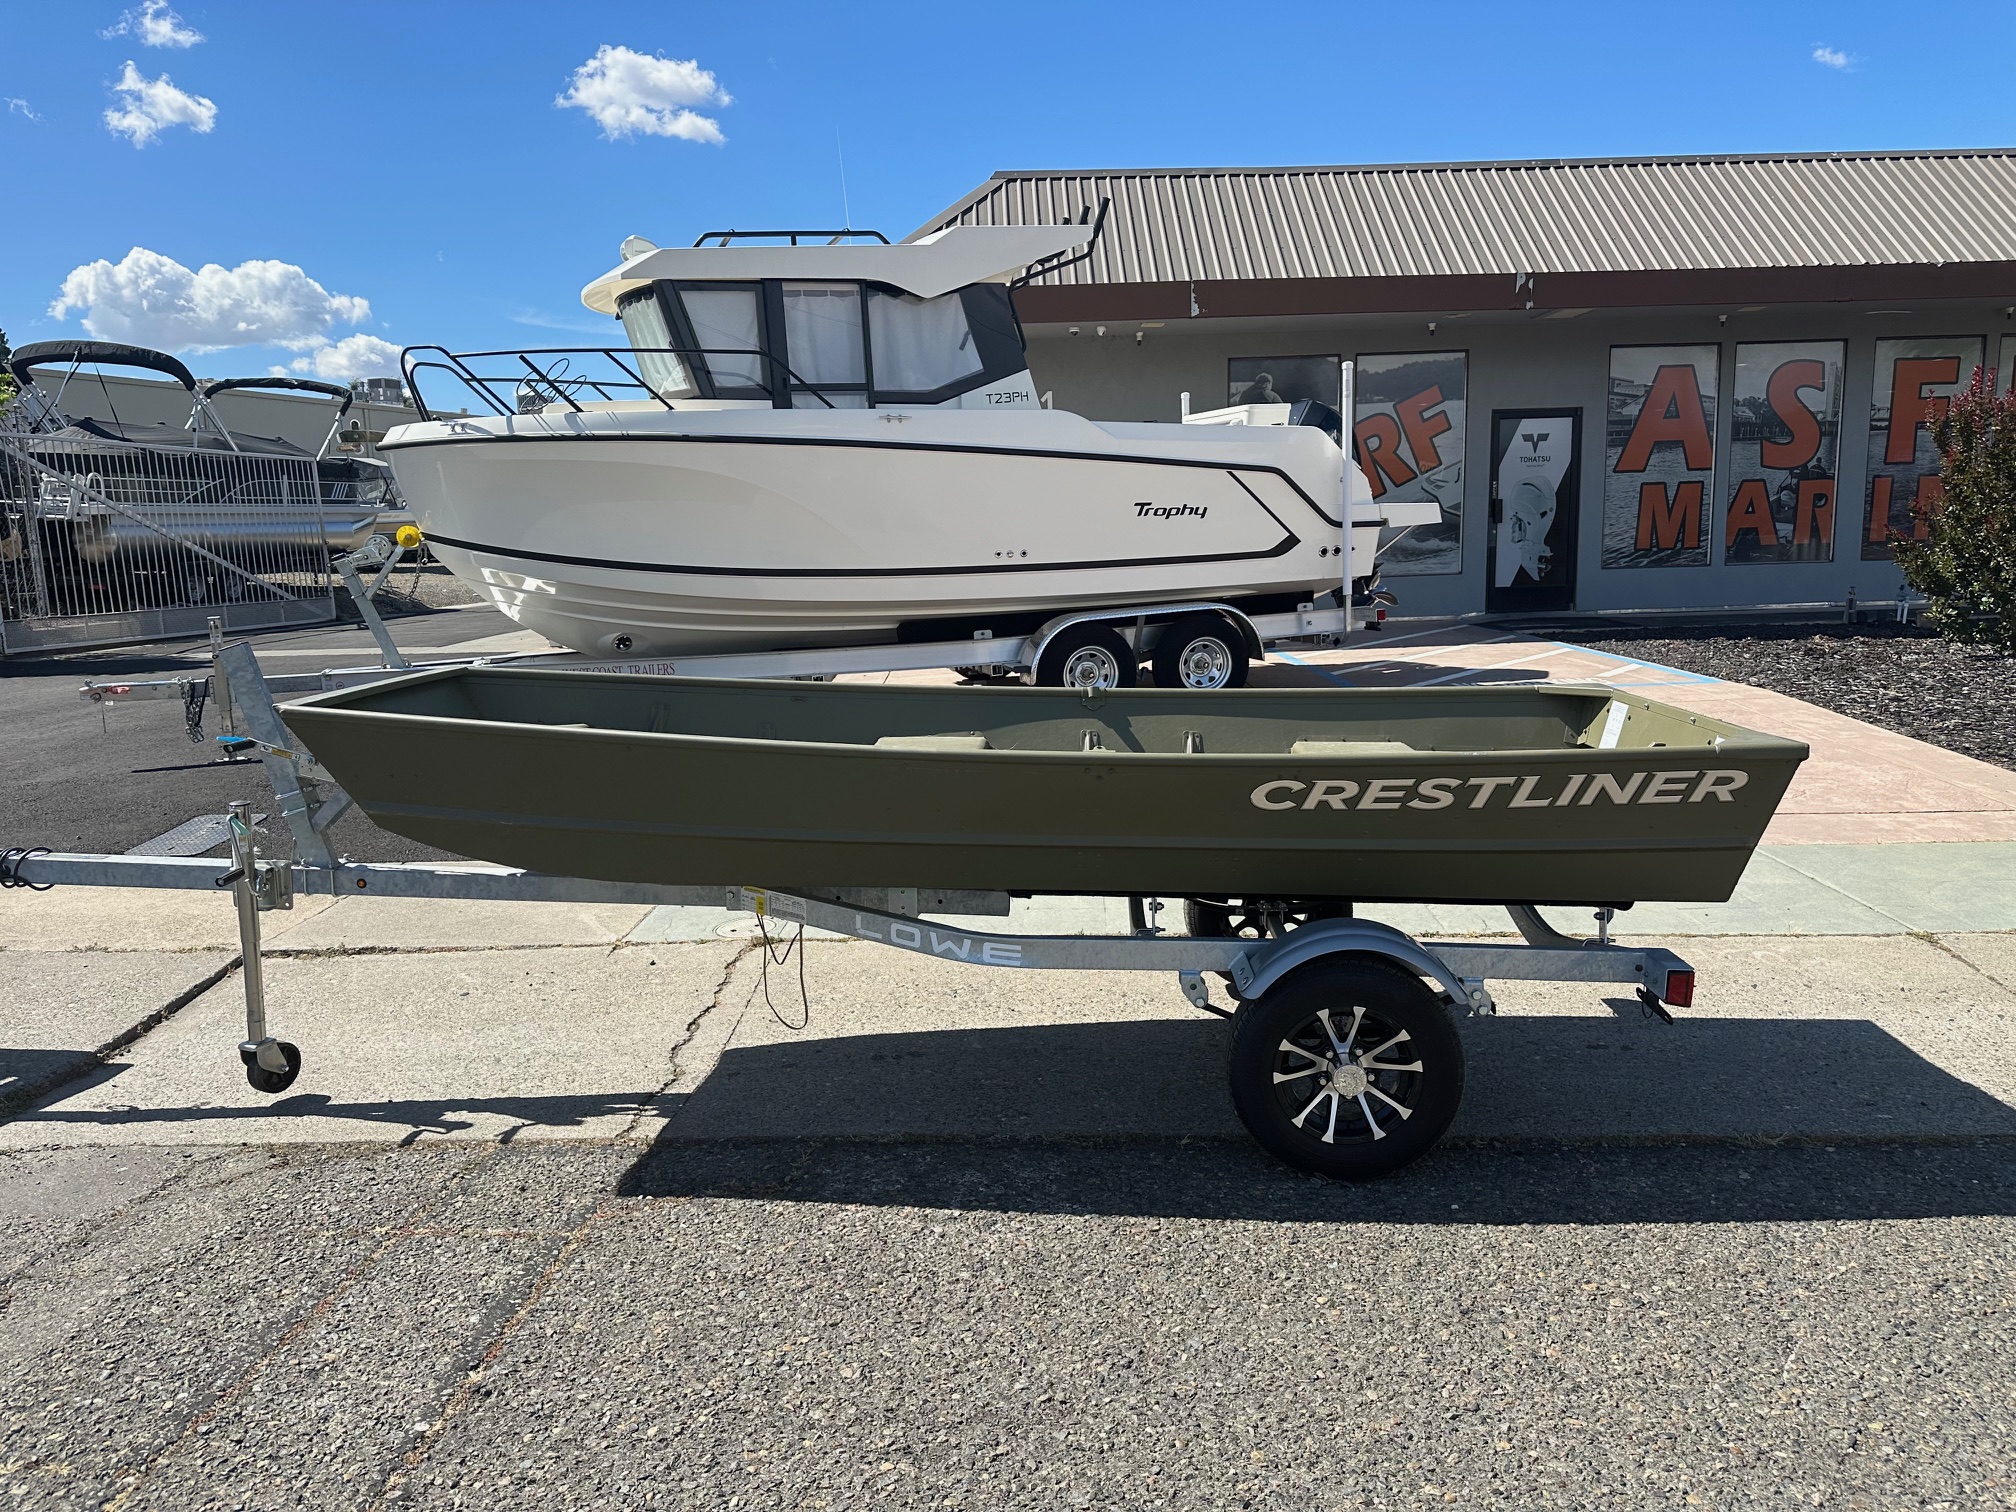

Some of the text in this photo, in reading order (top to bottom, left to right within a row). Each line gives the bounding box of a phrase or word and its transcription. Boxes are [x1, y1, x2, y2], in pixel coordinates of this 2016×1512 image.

[985, 391, 1029, 404] T23PH
[1519, 455, 1551, 463] TOHATSU
[1134, 502, 1208, 520] Trophy
[627, 662, 676, 675] TRAILERS
[1249, 769, 1750, 811] CRESTLINER
[855, 912, 1022, 967] LOWE
